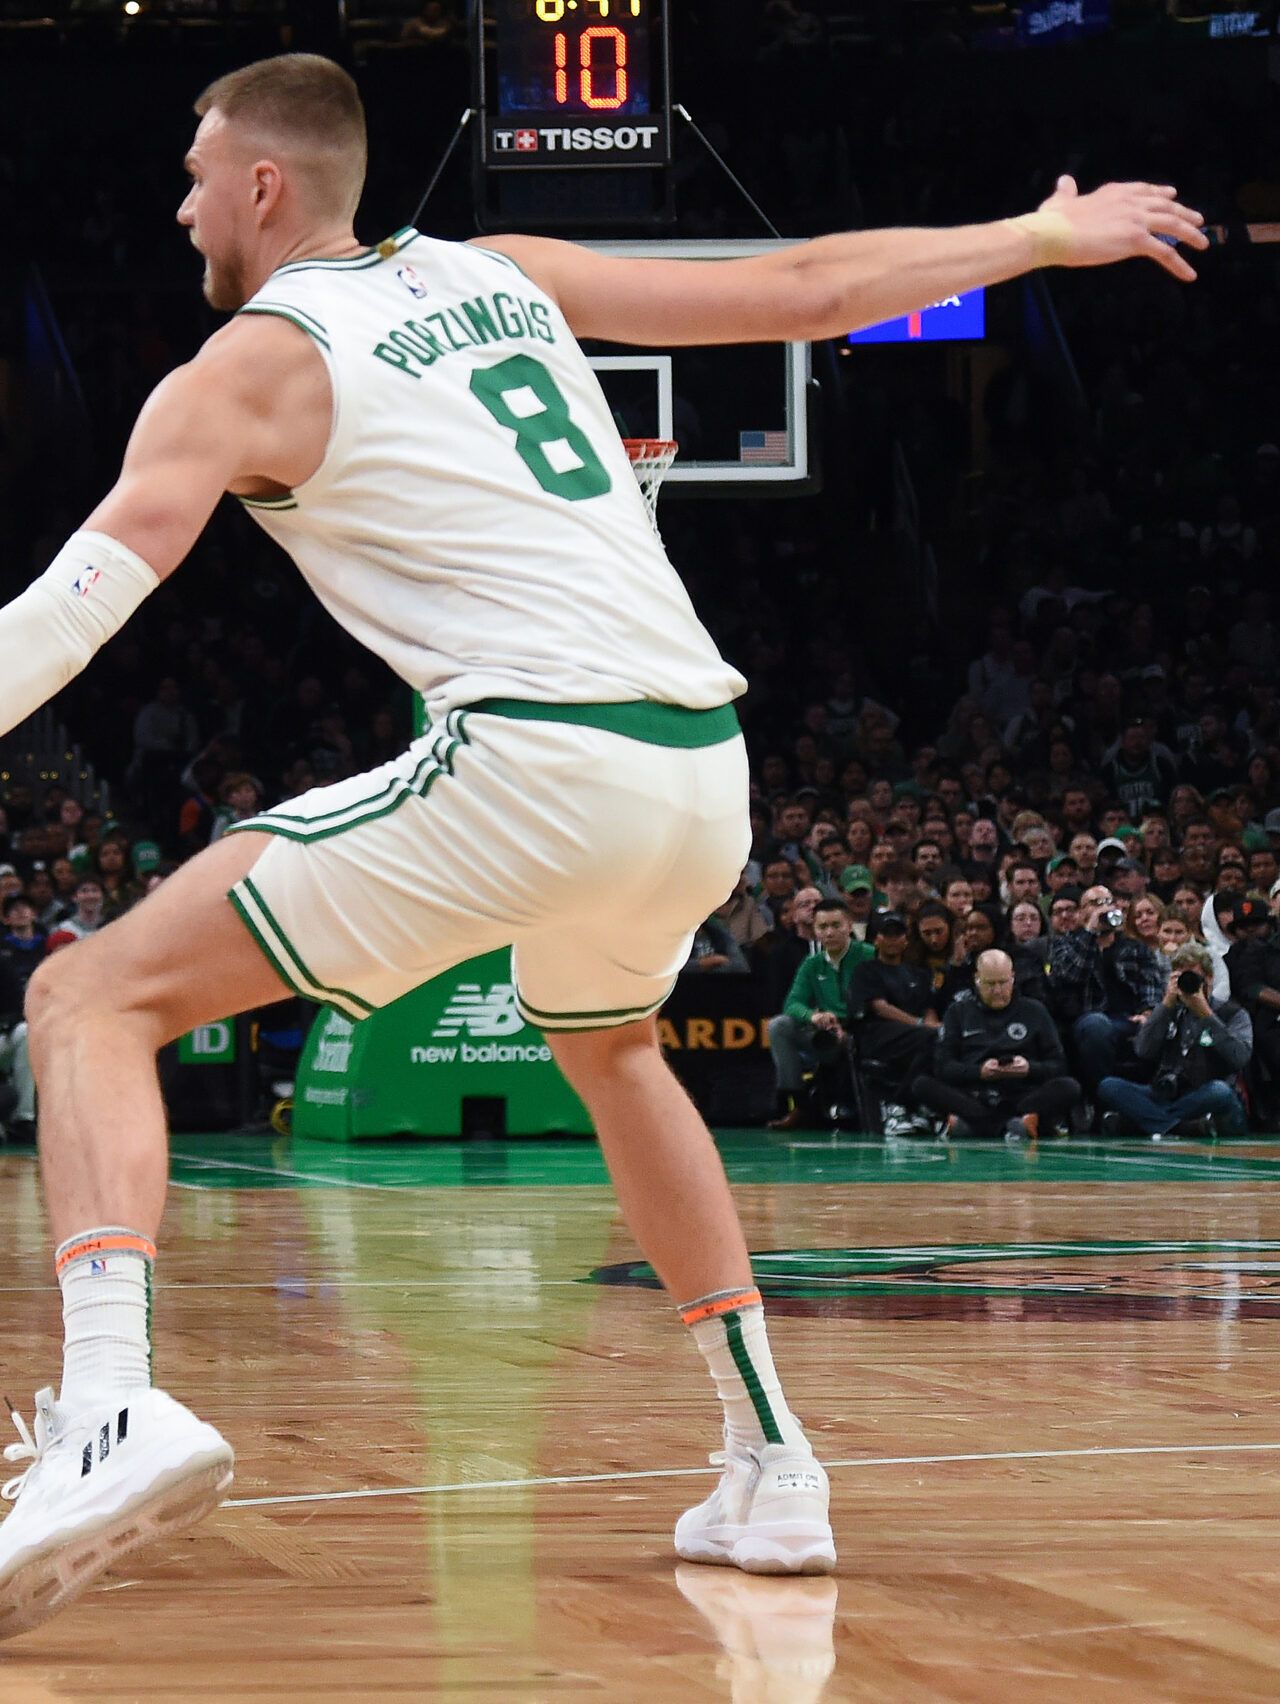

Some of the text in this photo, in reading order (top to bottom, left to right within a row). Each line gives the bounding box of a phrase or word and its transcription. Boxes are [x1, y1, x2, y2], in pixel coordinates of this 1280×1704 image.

[554, 26, 628, 110] 10
[539, 126, 660, 151] TISSOT
[372, 292, 556, 380] PORZINGIS
[469, 352, 613, 502] 8
[410, 1041, 554, 1064] new balance
